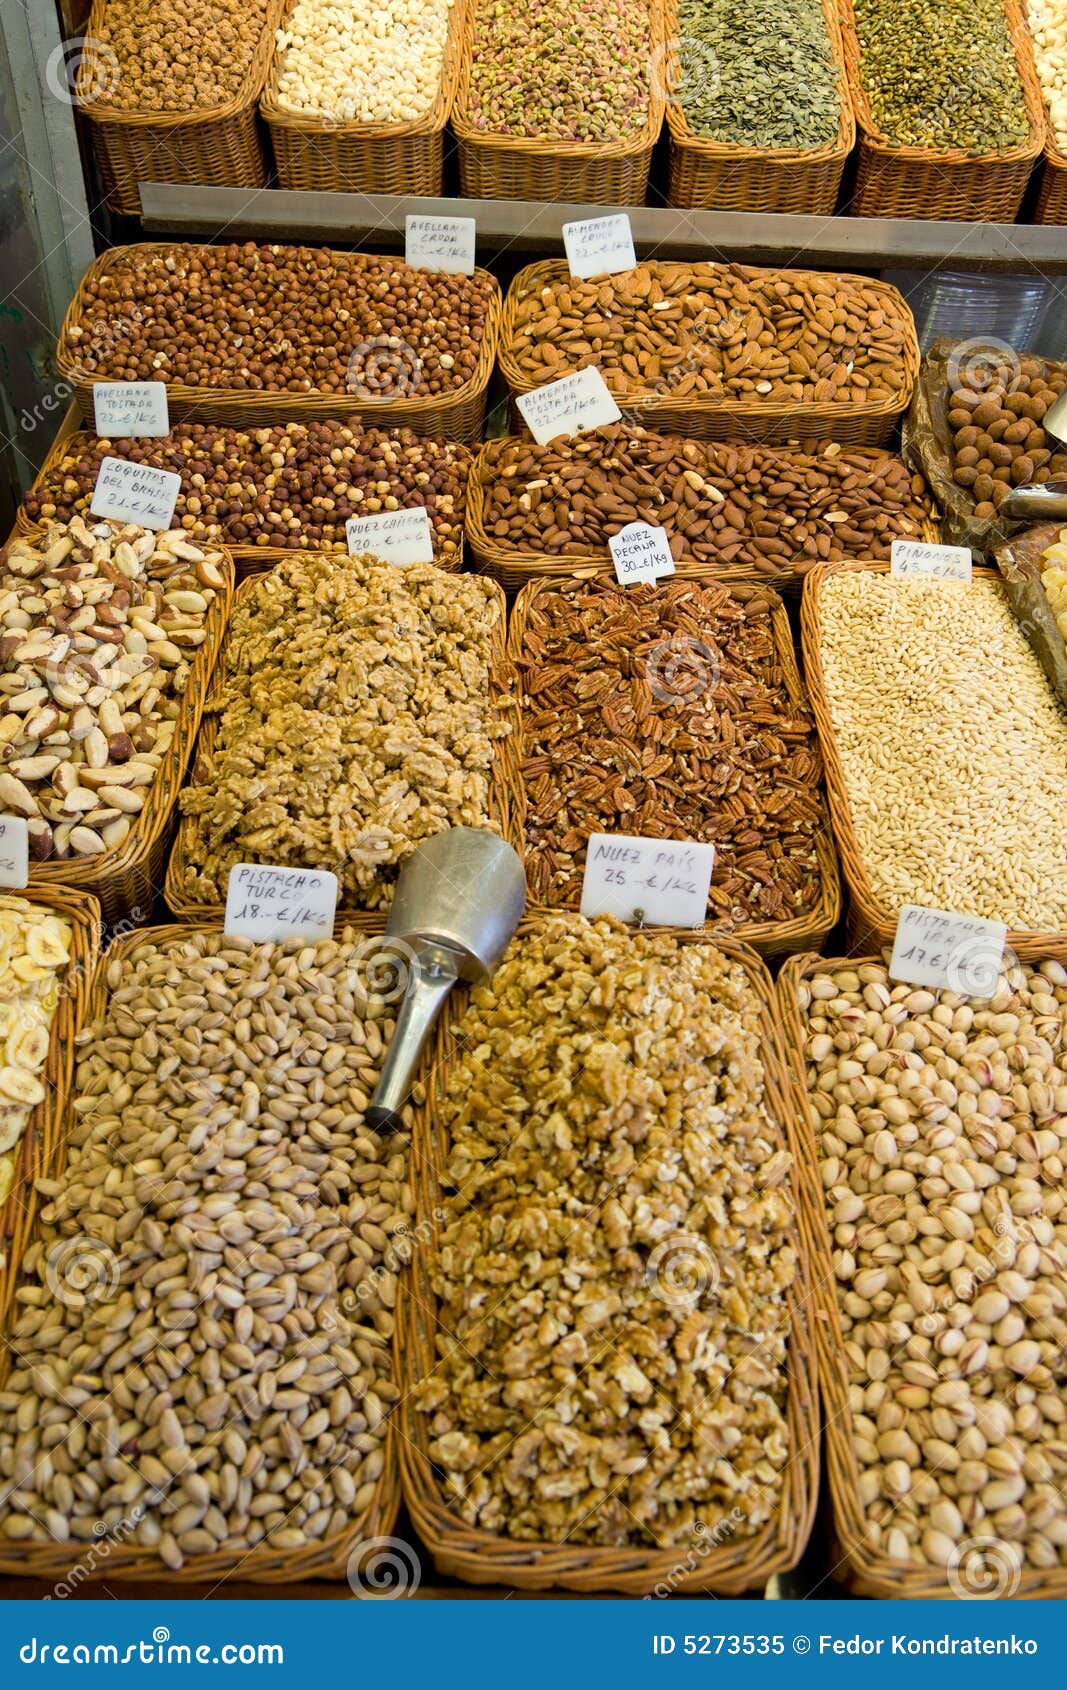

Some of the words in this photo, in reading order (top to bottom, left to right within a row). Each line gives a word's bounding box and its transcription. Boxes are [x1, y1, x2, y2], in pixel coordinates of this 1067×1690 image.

[103, 475, 122, 488] DEL
[106, 462, 166, 485] COQUITOS
[349, 521, 380, 535] NUEZ
[621, 530, 651, 543] NUEZ
[614, 540, 656, 559] PECANA
[594, 844, 641, 863] NUEZ
[239, 869, 322, 888] PISTACHO
